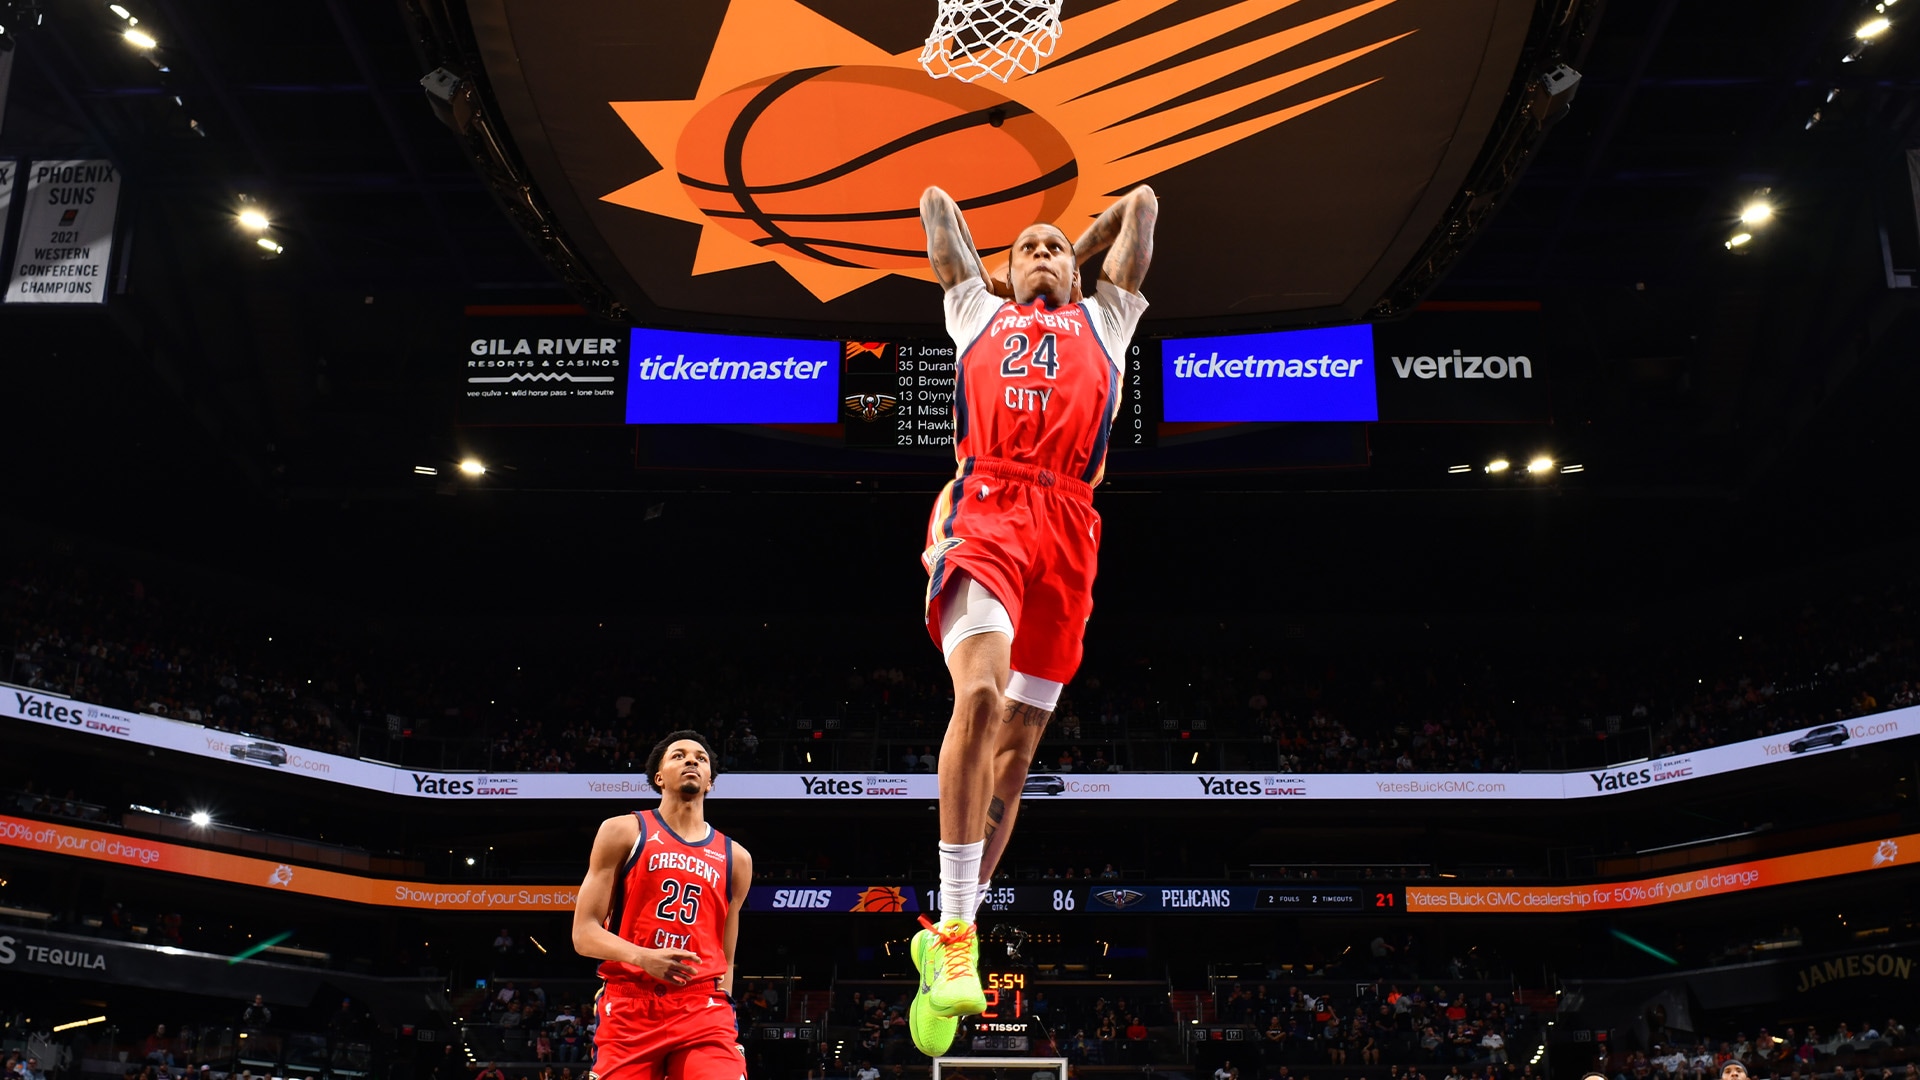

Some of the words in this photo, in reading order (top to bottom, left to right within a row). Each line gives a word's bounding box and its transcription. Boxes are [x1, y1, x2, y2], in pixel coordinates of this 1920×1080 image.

[37, 166, 114, 183] PHOENIX
[48, 187, 96, 205] SUNS
[51, 231, 79, 243] 2021
[34, 247, 90, 260] WESTERN
[19, 264, 99, 277] CONFERENCE
[20, 281, 92, 294] CHAMPIONS
[470, 338, 531, 356] GILA
[538, 338, 616, 355] RIVER
[899, 346, 912, 356] 21
[919, 346, 954, 356] Jones
[1132, 345, 1140, 355] 0
[1000, 333, 1060, 379] 24
[468, 360, 535, 368] RESORTS
[556, 359, 620, 367] CASINOS
[639, 354, 828, 381] ticketmaster
[899, 361, 913, 371] 35
[1133, 360, 1141, 370] 3
[1173, 352, 1364, 379] ticketmaster
[1391, 349, 1533, 380] verizon
[899, 376, 913, 386] 00
[919, 376, 955, 386] Brown
[1133, 375, 1141, 385] 2
[481, 390, 502, 398] quiva
[550, 390, 567, 398] pass
[899, 391, 913, 401] 13
[918, 391, 953, 403] Olyny
[1133, 389, 1141, 400] 3
[1005, 386, 1053, 411] CITY
[898, 405, 912, 415] 21
[918, 405, 948, 415] Missi
[1134, 404, 1142, 414] 0
[898, 420, 912, 430] 24
[918, 420, 954, 430] Hawki
[1134, 419, 1142, 429] 0
[898, 435, 913, 445] 25
[1134, 434, 1142, 444] 2
[15, 692, 83, 725] Yates
[86, 720, 131, 736] GMC
[412, 773, 474, 795] Yates
[800, 776, 863, 795] Yates
[1198, 776, 1262, 795] Yates
[1376, 781, 1506, 793] YatesBuickGMC.com
[1590, 769, 1651, 792] Yates
[1654, 767, 1693, 781] GMC
[0, 821, 32, 841] 50%
[34, 829, 56, 844] off
[56, 834, 89, 849] your
[90, 838, 106, 852] oil
[107, 841, 160, 864] change
[648, 852, 720, 888] CRESCENT
[395, 886, 434, 902] Show
[435, 890, 472, 905] proof
[472, 890, 487, 904] of
[487, 893, 516, 907] your
[518, 890, 552, 904] Suns
[1411, 892, 1447, 905] Yates
[1450, 892, 1485, 906] Buick
[1487, 892, 1521, 906] GMC
[1523, 891, 1591, 907] dealership
[1593, 889, 1611, 903] for
[1614, 886, 1646, 902] 50%
[1648, 882, 1664, 898] off
[1666, 880, 1693, 899] your
[1696, 876, 1708, 890] oil
[1710, 869, 1758, 887] change
[656, 878, 702, 925] 25
[1053, 889, 1075, 911] 86
[1162, 889, 1230, 907] PELICANS
[1376, 893, 1394, 907] 21
[654, 928, 690, 950] CITY
[25, 945, 106, 971] TEQUILA
[989, 973, 1024, 989] 5:54
[1796, 953, 1913, 993] JAMESON
[982, 990, 1021, 1018] 21
[989, 1023, 1028, 1032] TISSOT
